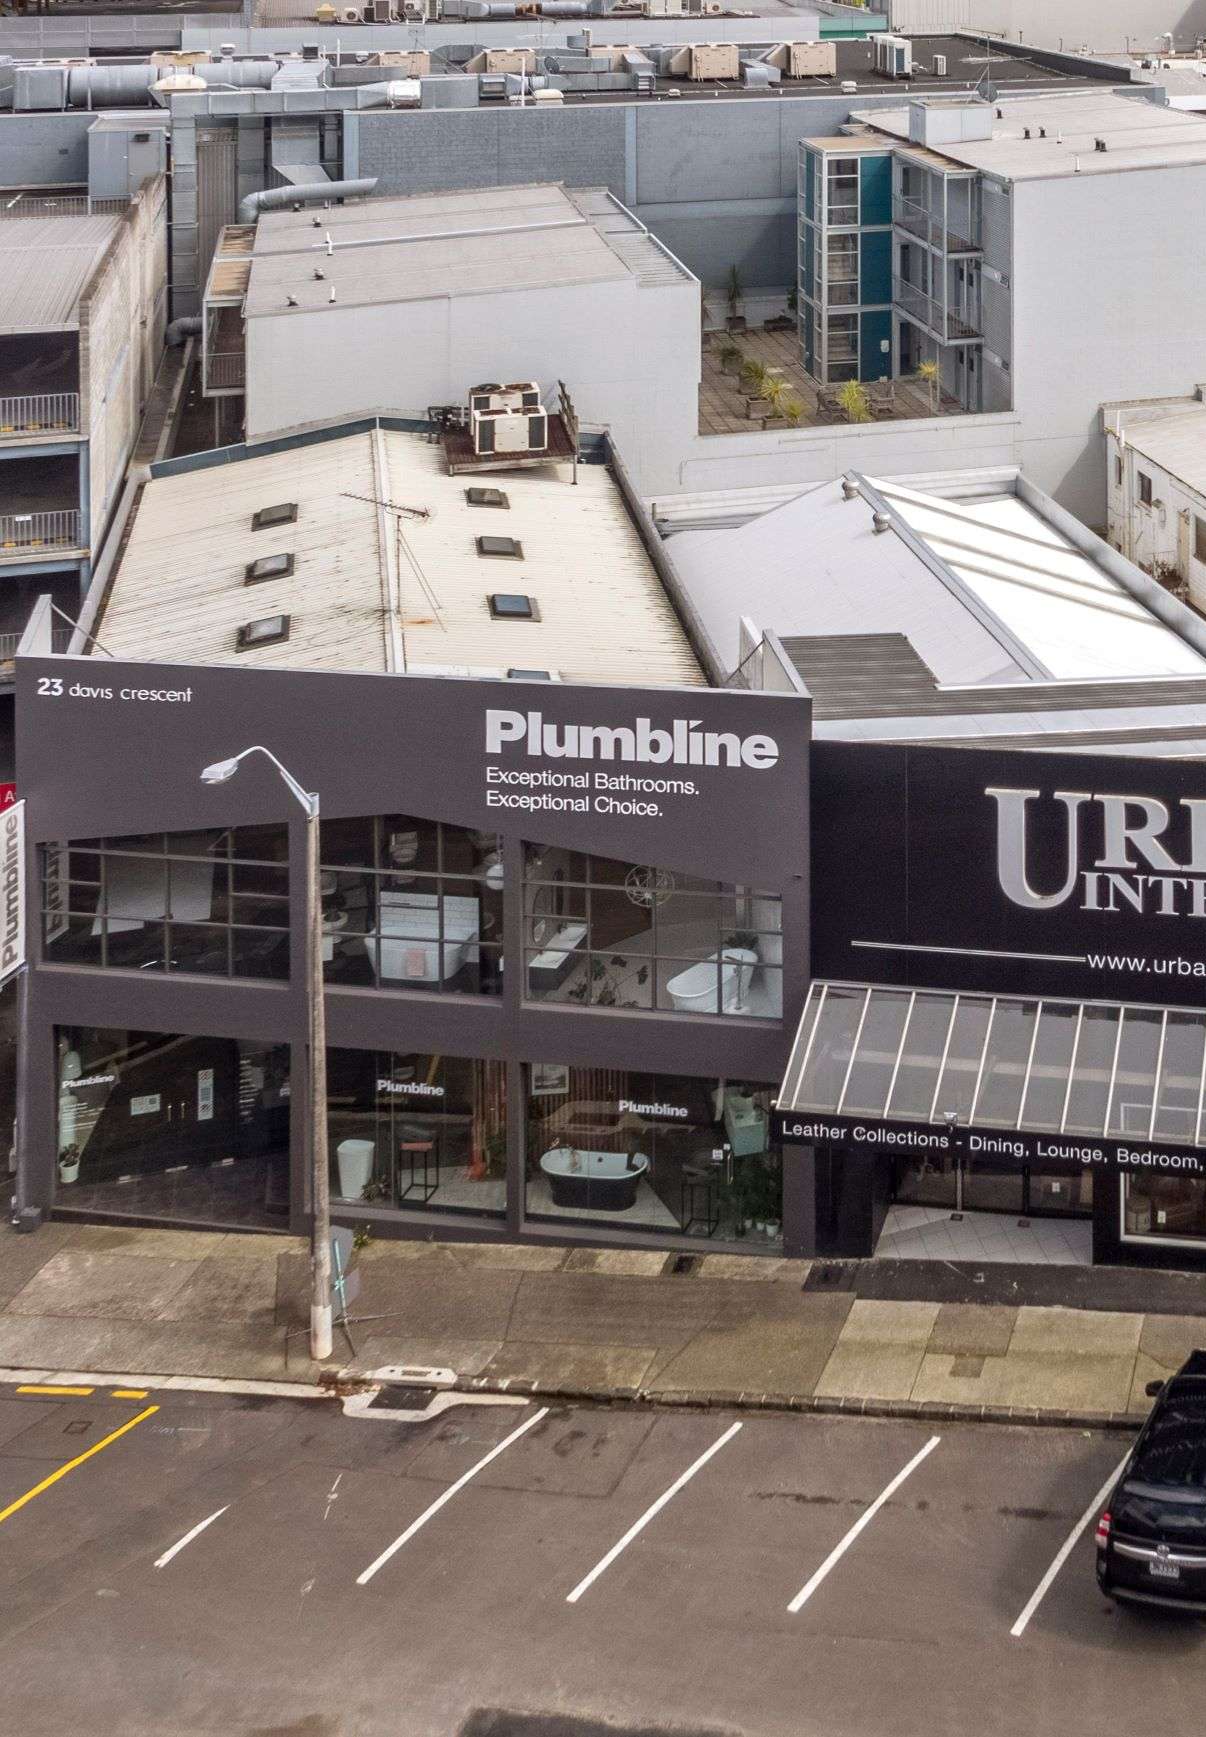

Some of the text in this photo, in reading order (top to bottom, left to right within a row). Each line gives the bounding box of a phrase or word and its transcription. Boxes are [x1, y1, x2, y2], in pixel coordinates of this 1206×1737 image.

[37, 677, 193, 702] 23 davis crescent
[486, 766, 700, 795] Exceptional Bathrooms.
[486, 790, 663, 817] Exceptional Choice.
[782, 1119, 852, 1141] Leather
[854, 1126, 949, 1149] Collections
[970, 1135, 1030, 1158] Dining,
[1037, 1142, 1108, 1164] Lounge,
[1117, 1149, 1204, 1172] Bedroom,
